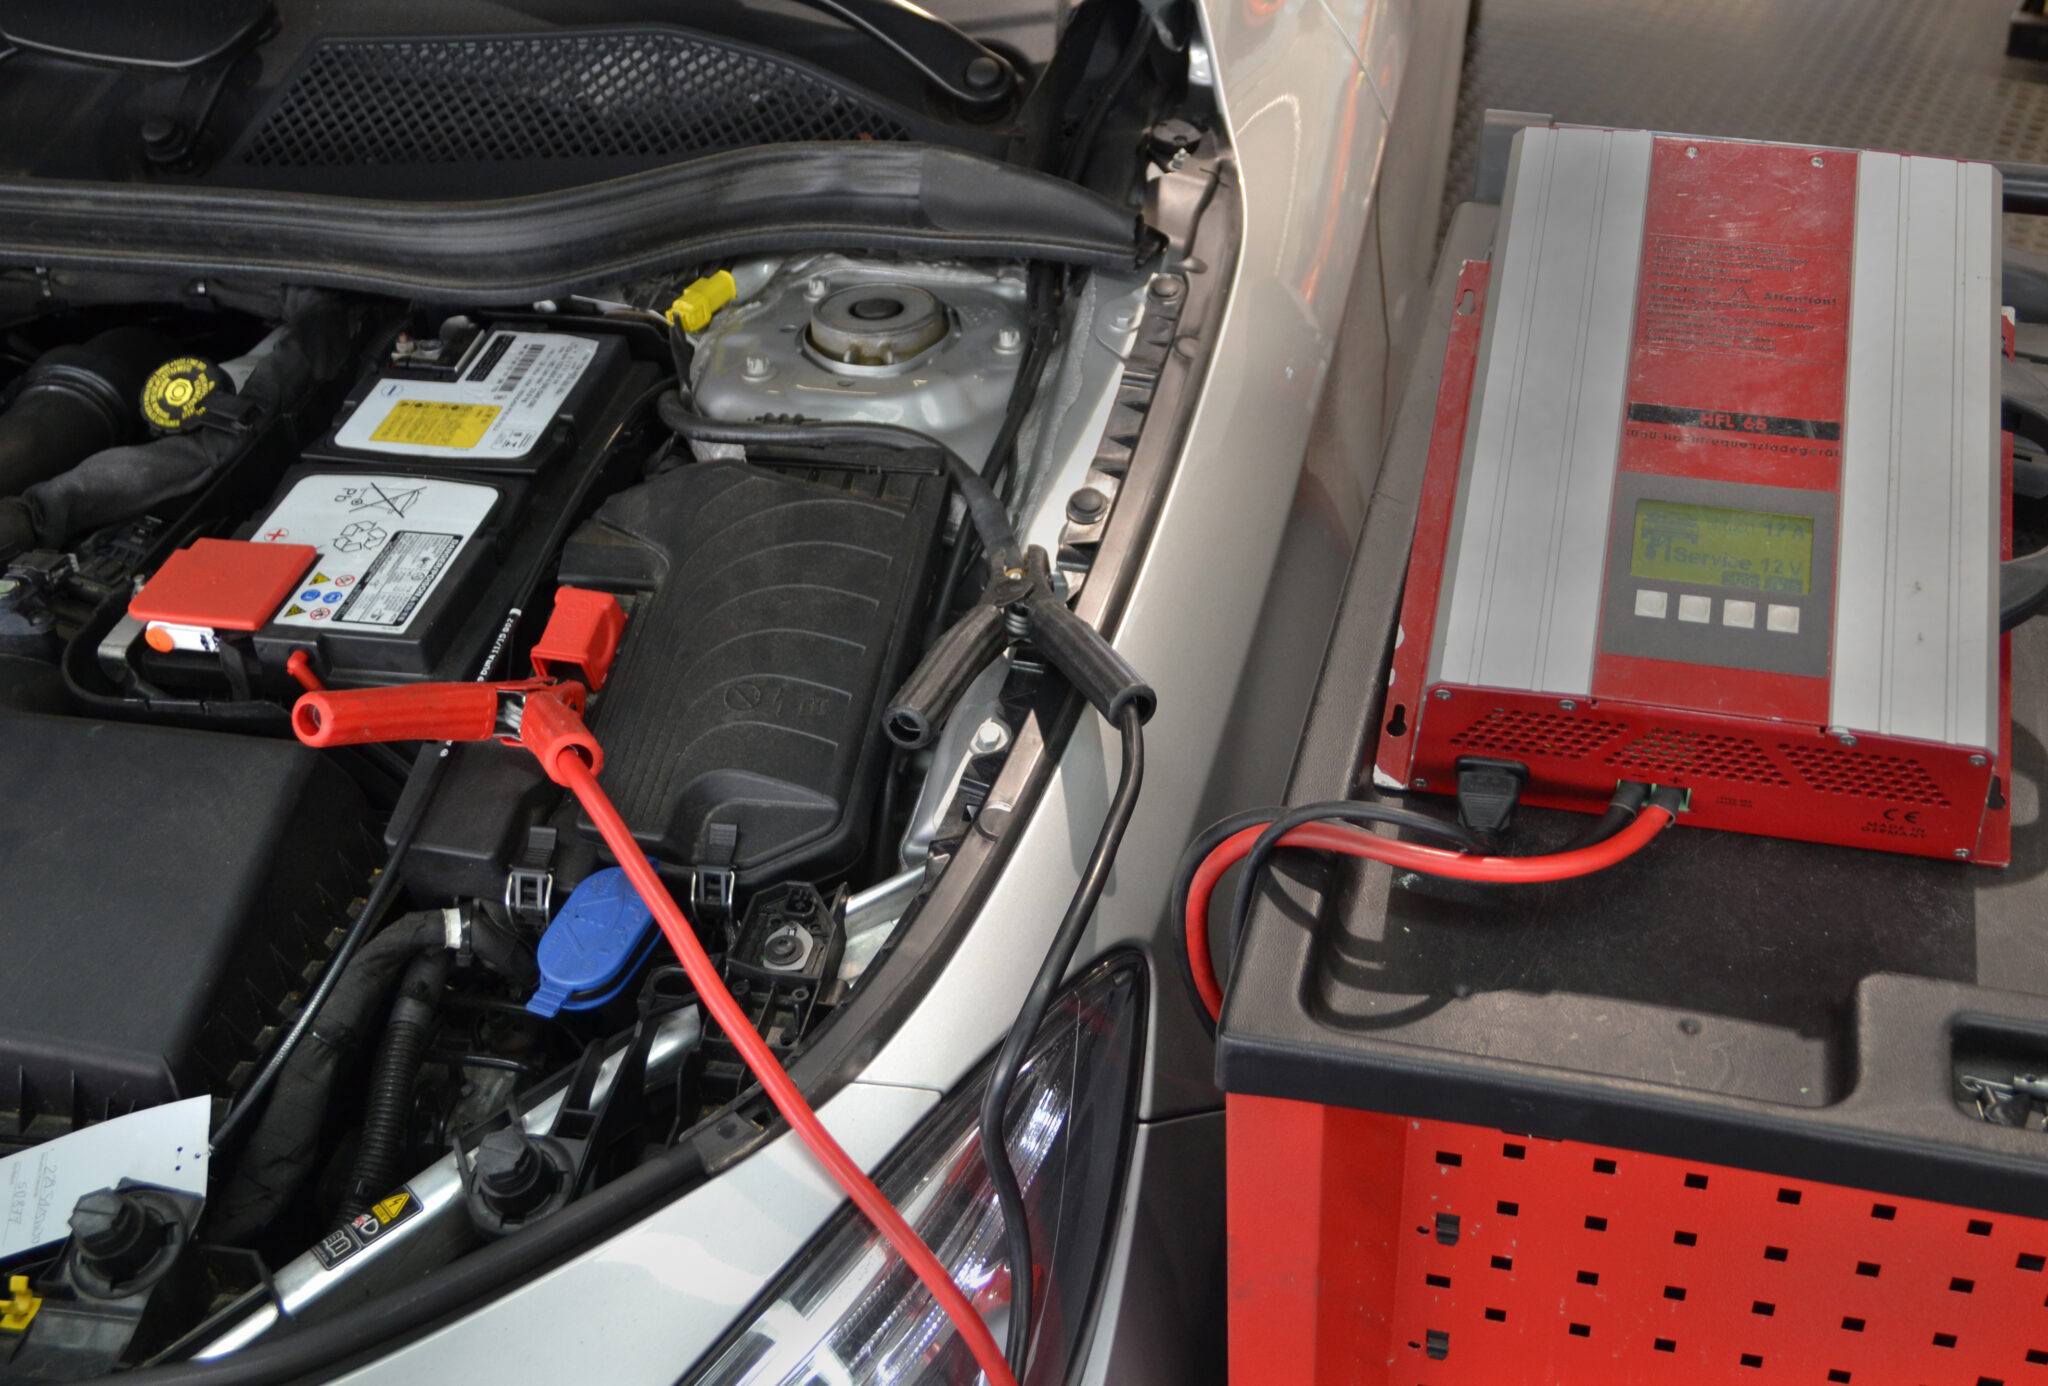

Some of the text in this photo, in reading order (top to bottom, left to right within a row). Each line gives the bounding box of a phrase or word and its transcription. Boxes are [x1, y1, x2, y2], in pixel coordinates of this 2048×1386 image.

[1650, 281, 1717, 294] Vorsicht!
[1764, 291, 1837, 306] Attention!
[1700, 412, 1768, 431] HFL 65
[1764, 522, 1788, 537] 17
[1792, 525, 1806, 541] A
[1673, 546, 1804, 577] Service 12 V
[480, 654, 497, 676] DURA
[1861, 826, 1927, 839] GERMANY
[1867, 821, 1904, 831] MADE
